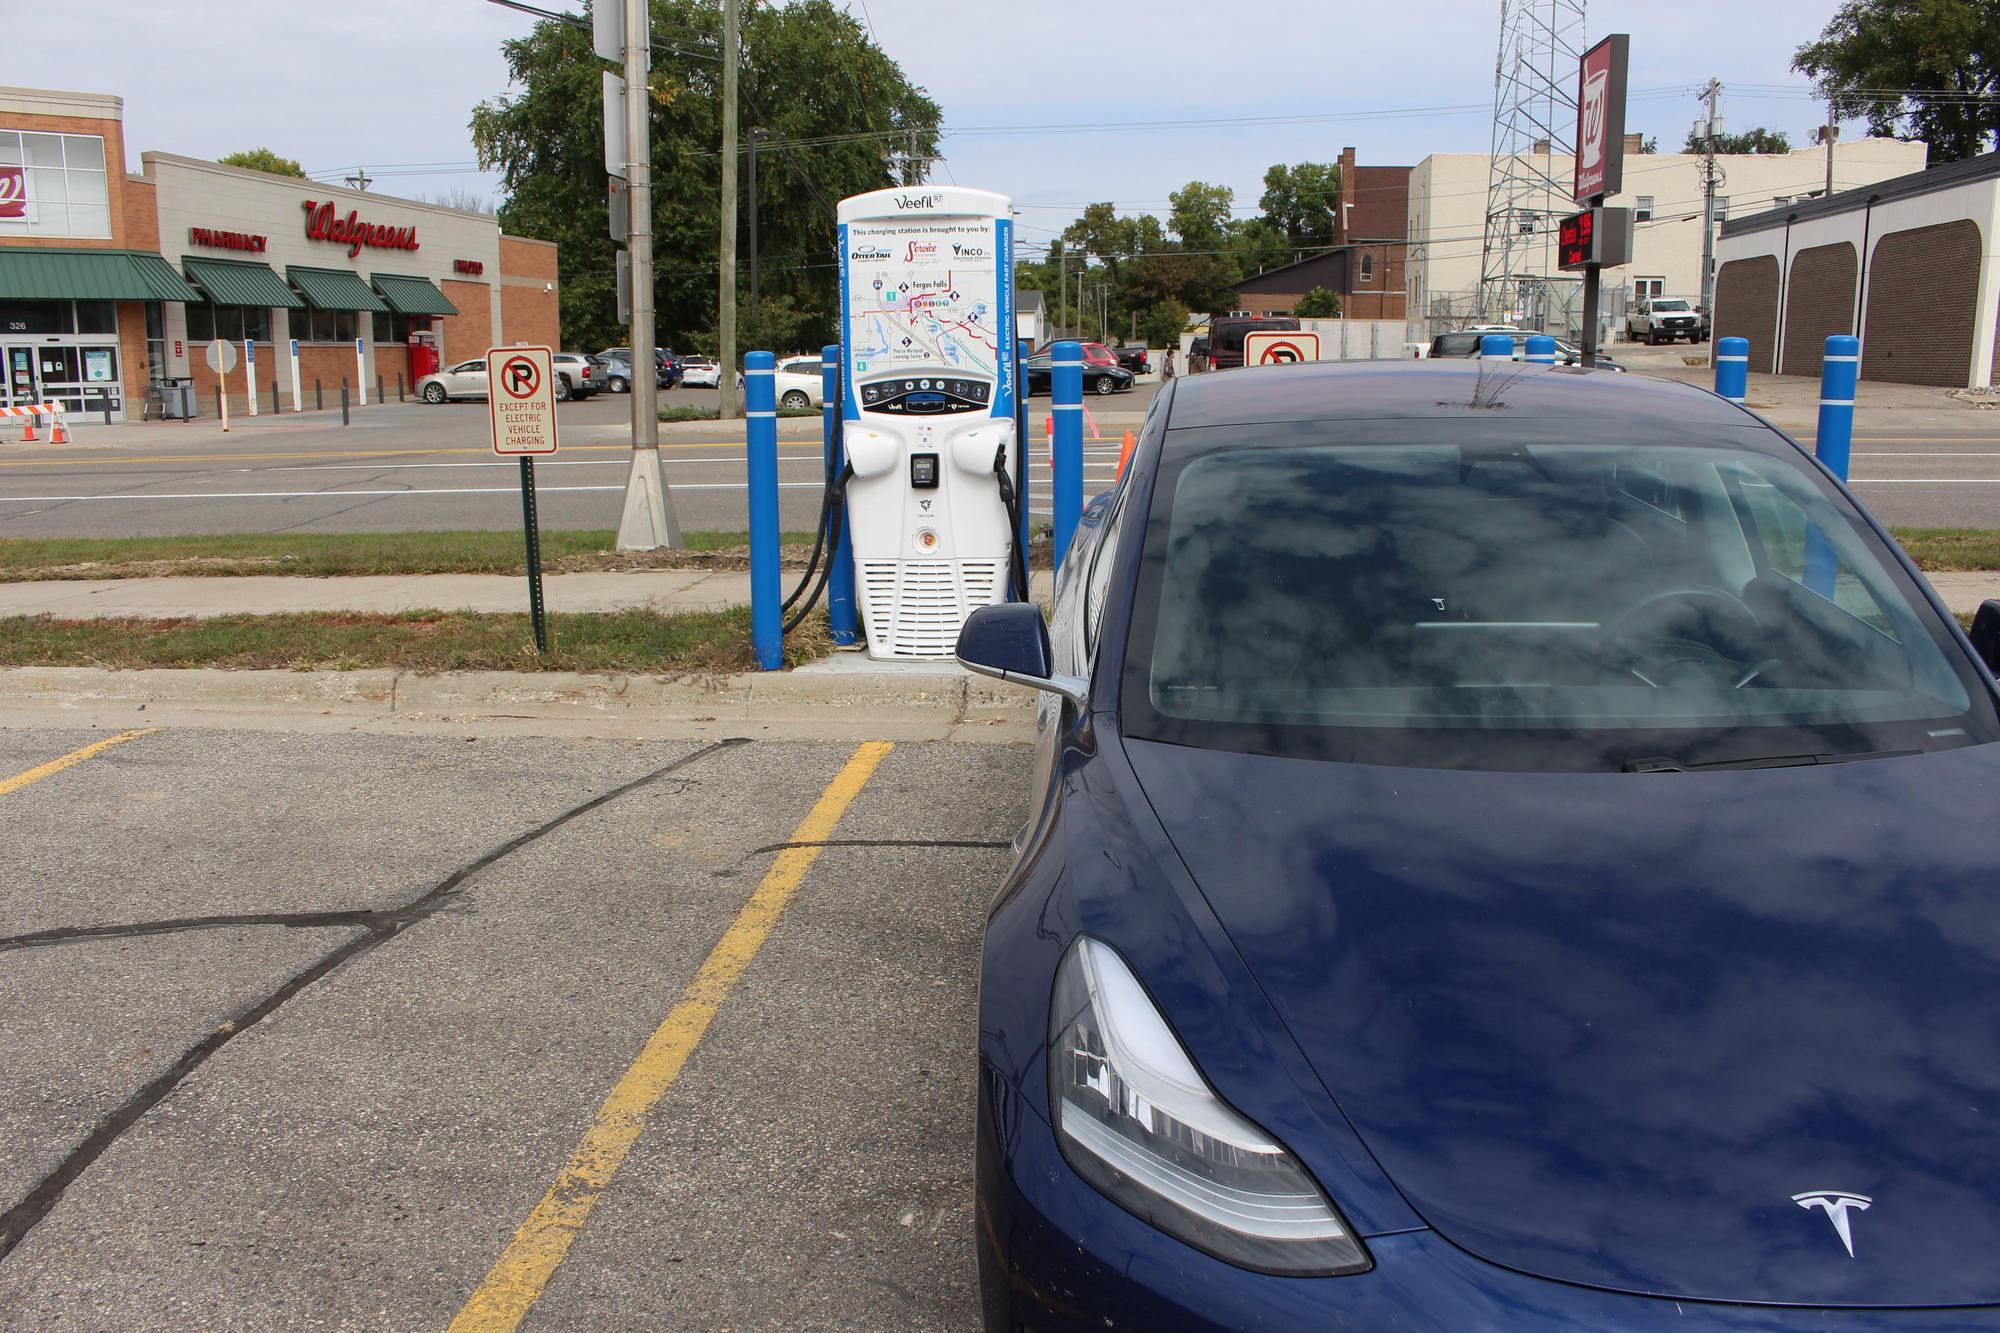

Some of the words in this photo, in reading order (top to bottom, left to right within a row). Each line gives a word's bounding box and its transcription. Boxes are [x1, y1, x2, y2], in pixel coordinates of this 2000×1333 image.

[1578, 170, 1602, 192] Walgreens
[894, 195, 934, 209] Veefil
[304, 200, 420, 258] Walgreens
[930, 226, 956, 235] brought
[980, 226, 991, 234] by:
[191, 228, 267, 252] PHARMACY
[904, 240, 936, 264] Service
[912, 281, 932, 290] Fergus
[1002, 360, 1012, 397] Veefil
[500, 402, 528, 411] EXCEPT
[531, 402, 546, 410] FOR
[506, 414, 541, 423] ELECTRIC
[508, 425, 540, 434] VEHICLE
[506, 436, 545, 445] CHARGING
